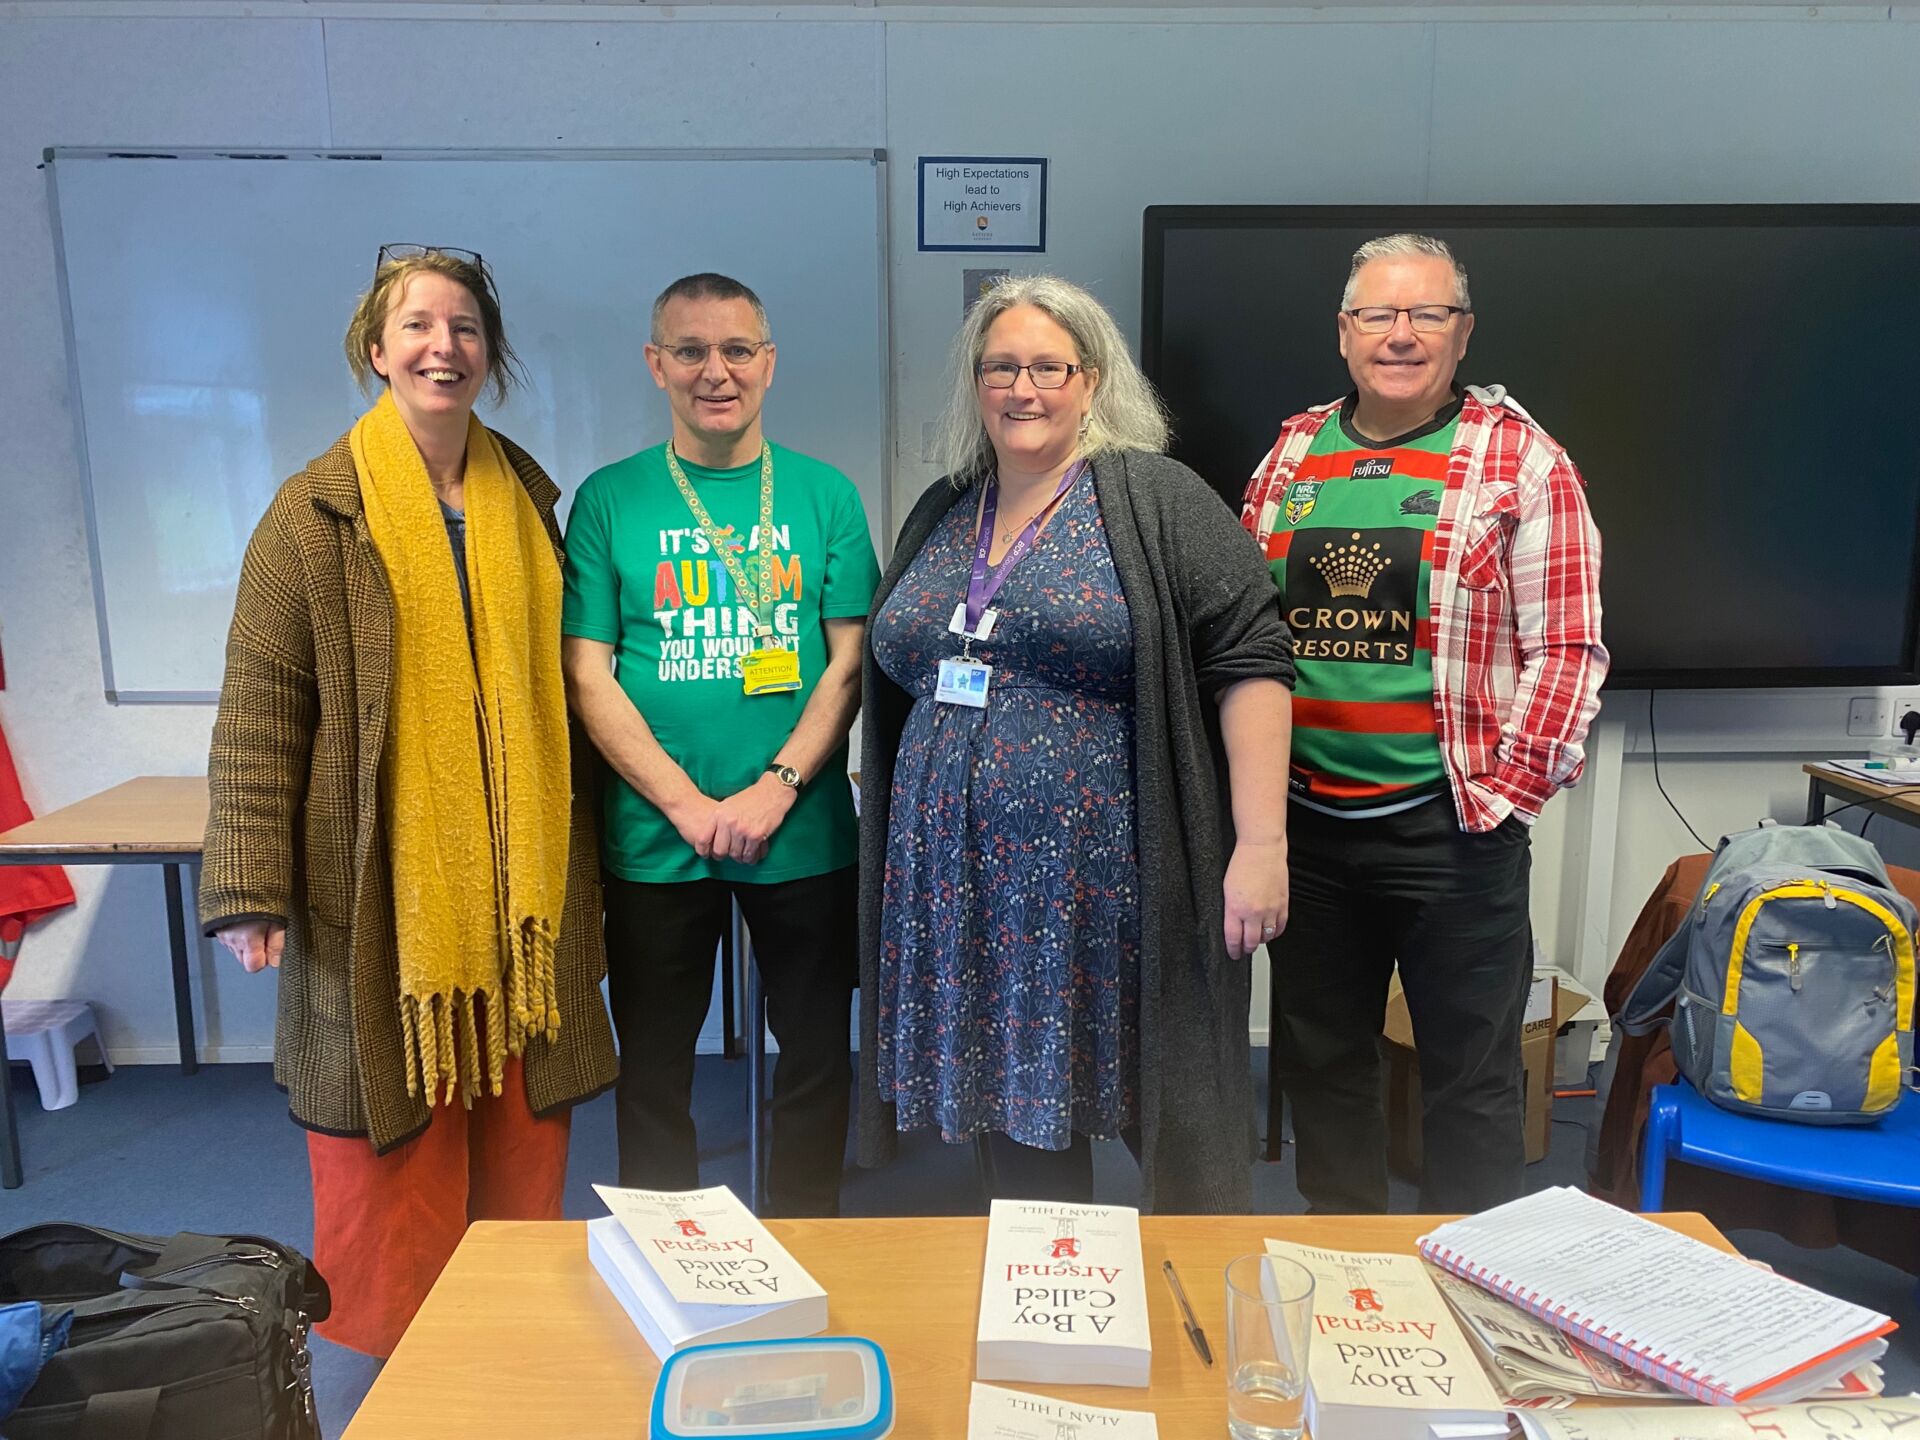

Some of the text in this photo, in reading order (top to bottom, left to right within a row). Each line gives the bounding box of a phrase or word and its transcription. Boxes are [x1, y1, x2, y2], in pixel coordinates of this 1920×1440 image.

[936, 168, 1029, 180] High Expectations
[965, 184, 1000, 195] lead to
[944, 201, 1021, 213] High Achievers
[1352, 458, 1391, 477] FUJITSU
[1296, 485, 1315, 493] NRL
[659, 527, 711, 556] IT'S
[994, 540, 1025, 579] BCP Council
[1288, 607, 1411, 632] CROWN
[660, 638, 695, 661] YOU
[1292, 639, 1408, 661] RESORTS
[750, 665, 792, 676] ATTENTION
[1525, 1018, 1551, 1033] CARE
[1019, 1206, 1053, 1214] HILL
[1069, 1208, 1111, 1217] ALAN
[651, 1238, 754, 1254] Arsenal
[1297, 1249, 1335, 1262] HILL
[675, 1258, 769, 1276] Called
[1350, 1257, 1392, 1266] ALAN
[1006, 1263, 1123, 1284] Arsenal
[696, 1275, 780, 1295] A Boy
[1014, 1288, 1116, 1308] Called
[1012, 1306, 1115, 1334] A Boy
[1313, 1313, 1437, 1341] Arsenal
[1334, 1343, 1447, 1368] Called
[1349, 1365, 1456, 1397] A Boy
[1007, 1398, 1120, 1426] ALAN J HILL
